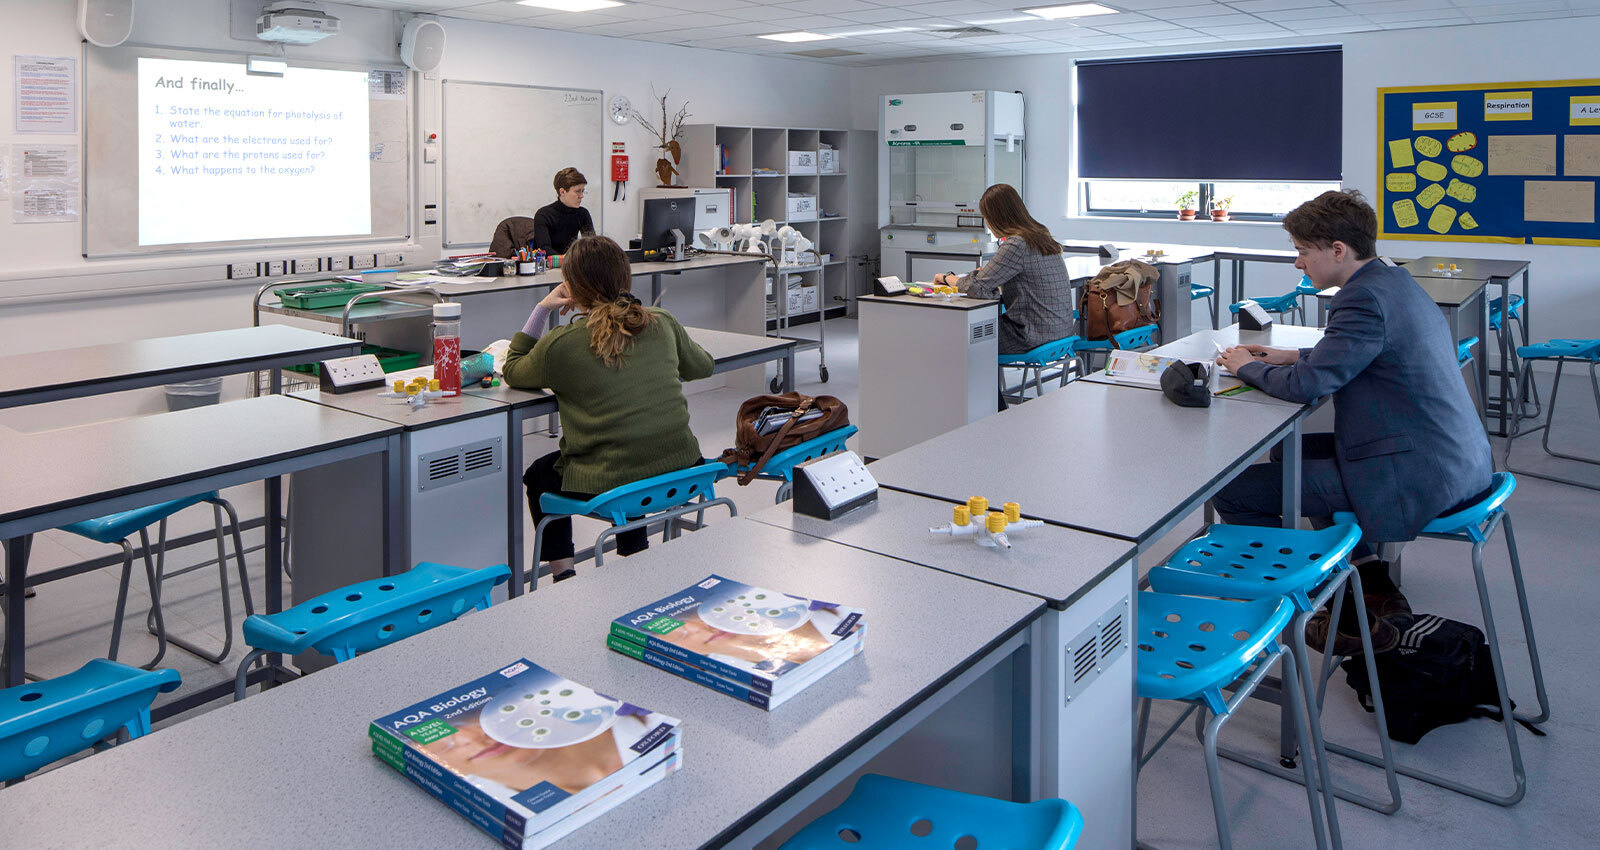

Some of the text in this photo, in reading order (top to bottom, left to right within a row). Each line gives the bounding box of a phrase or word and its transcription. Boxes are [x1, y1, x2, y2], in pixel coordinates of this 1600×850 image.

[154, 76, 184, 89] And
[1486, 102, 1530, 110] Respiration
[1590, 106, 1600, 114] Le
[155, 104, 344, 122] 1. State the equation for photolysis of
[170, 120, 202, 128] water.
[155, 134, 333, 146] 2. What are the electrons used for?
[155, 149, 326, 161] 3. What are the protons used for?
[155, 165, 315, 177] 4. What happens to the oxygen?
[630, 596, 695, 626] AQA Biology
[836, 614, 857, 635] OXFORD
[657, 643, 668, 651] Biology
[652, 656, 665, 666] Biology
[672, 664, 684, 672] Edition
[394, 686, 487, 729] AQA Biology
[444, 696, 494, 719] 2nd Edition
[416, 721, 443, 733] LEVEL
[439, 728, 451, 737] AS
[637, 726, 669, 750] OXFORD
